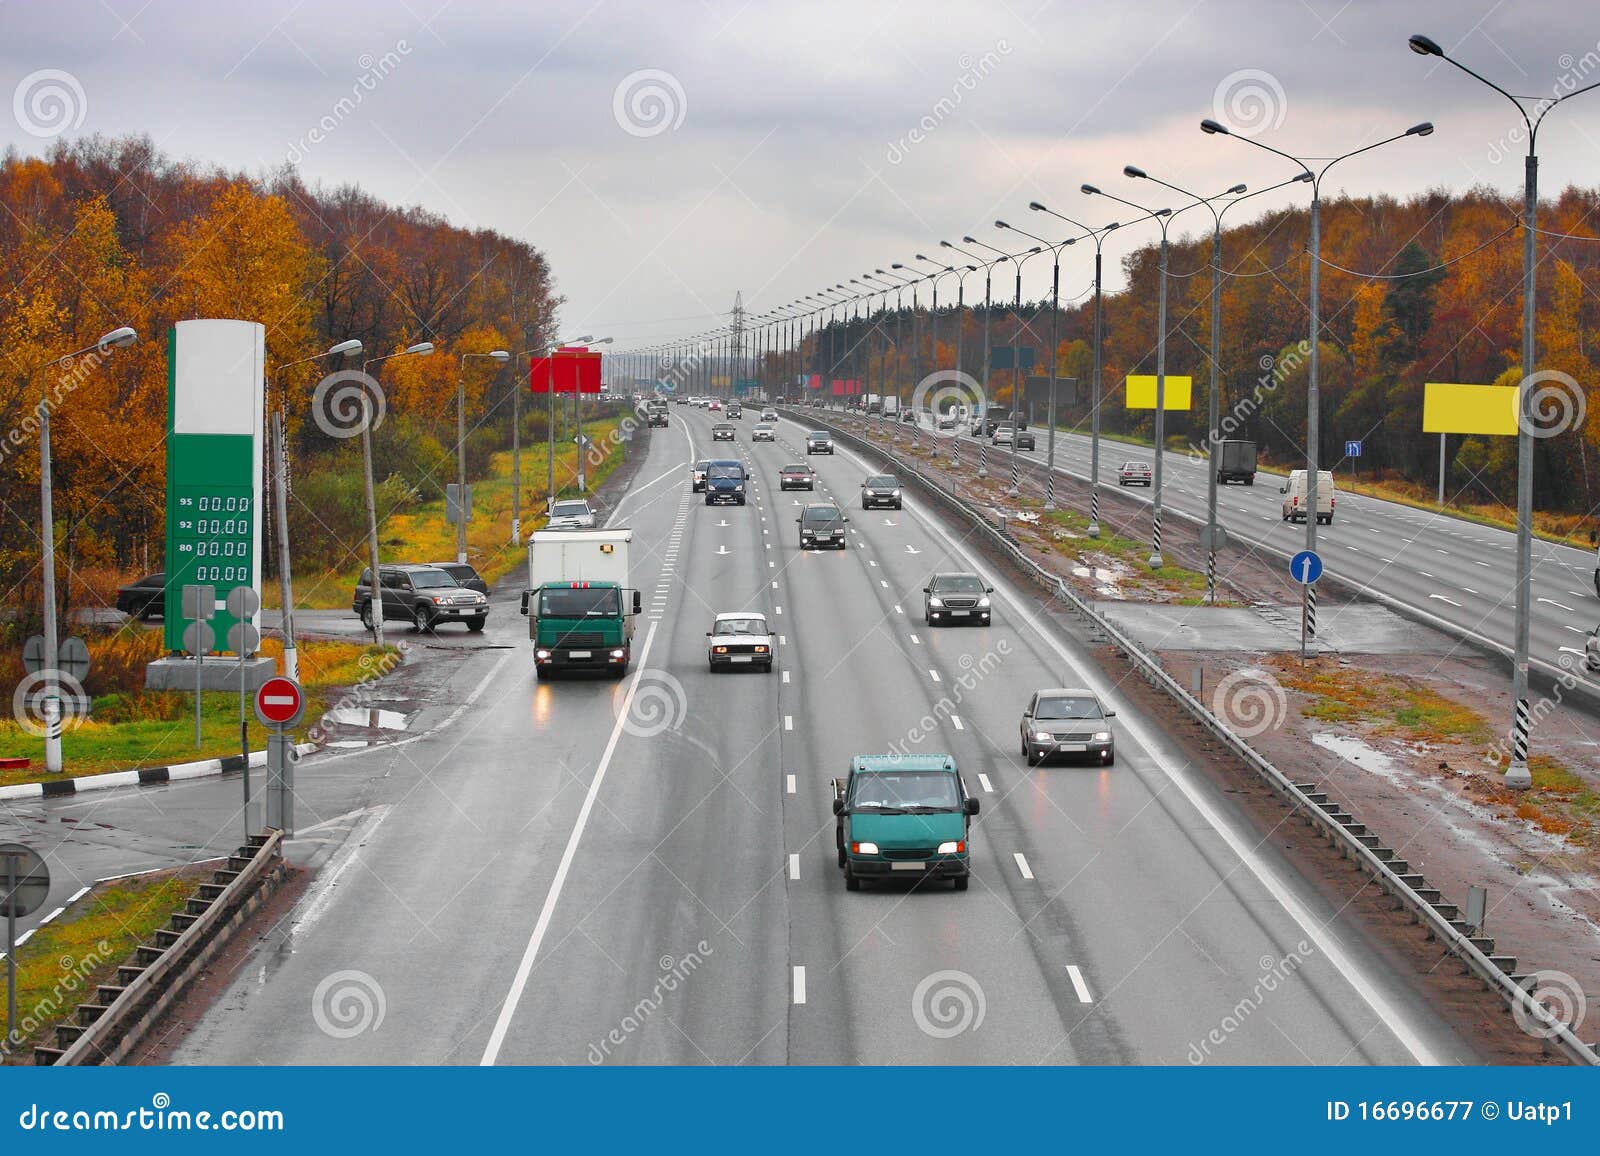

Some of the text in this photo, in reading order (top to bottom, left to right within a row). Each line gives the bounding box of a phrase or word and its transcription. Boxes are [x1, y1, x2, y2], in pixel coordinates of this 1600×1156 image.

[199, 497, 249, 511] 00.00
[197, 519, 248, 534] 00.00
[196, 542, 247, 556] 00.00
[197, 566, 247, 581] 00.00
